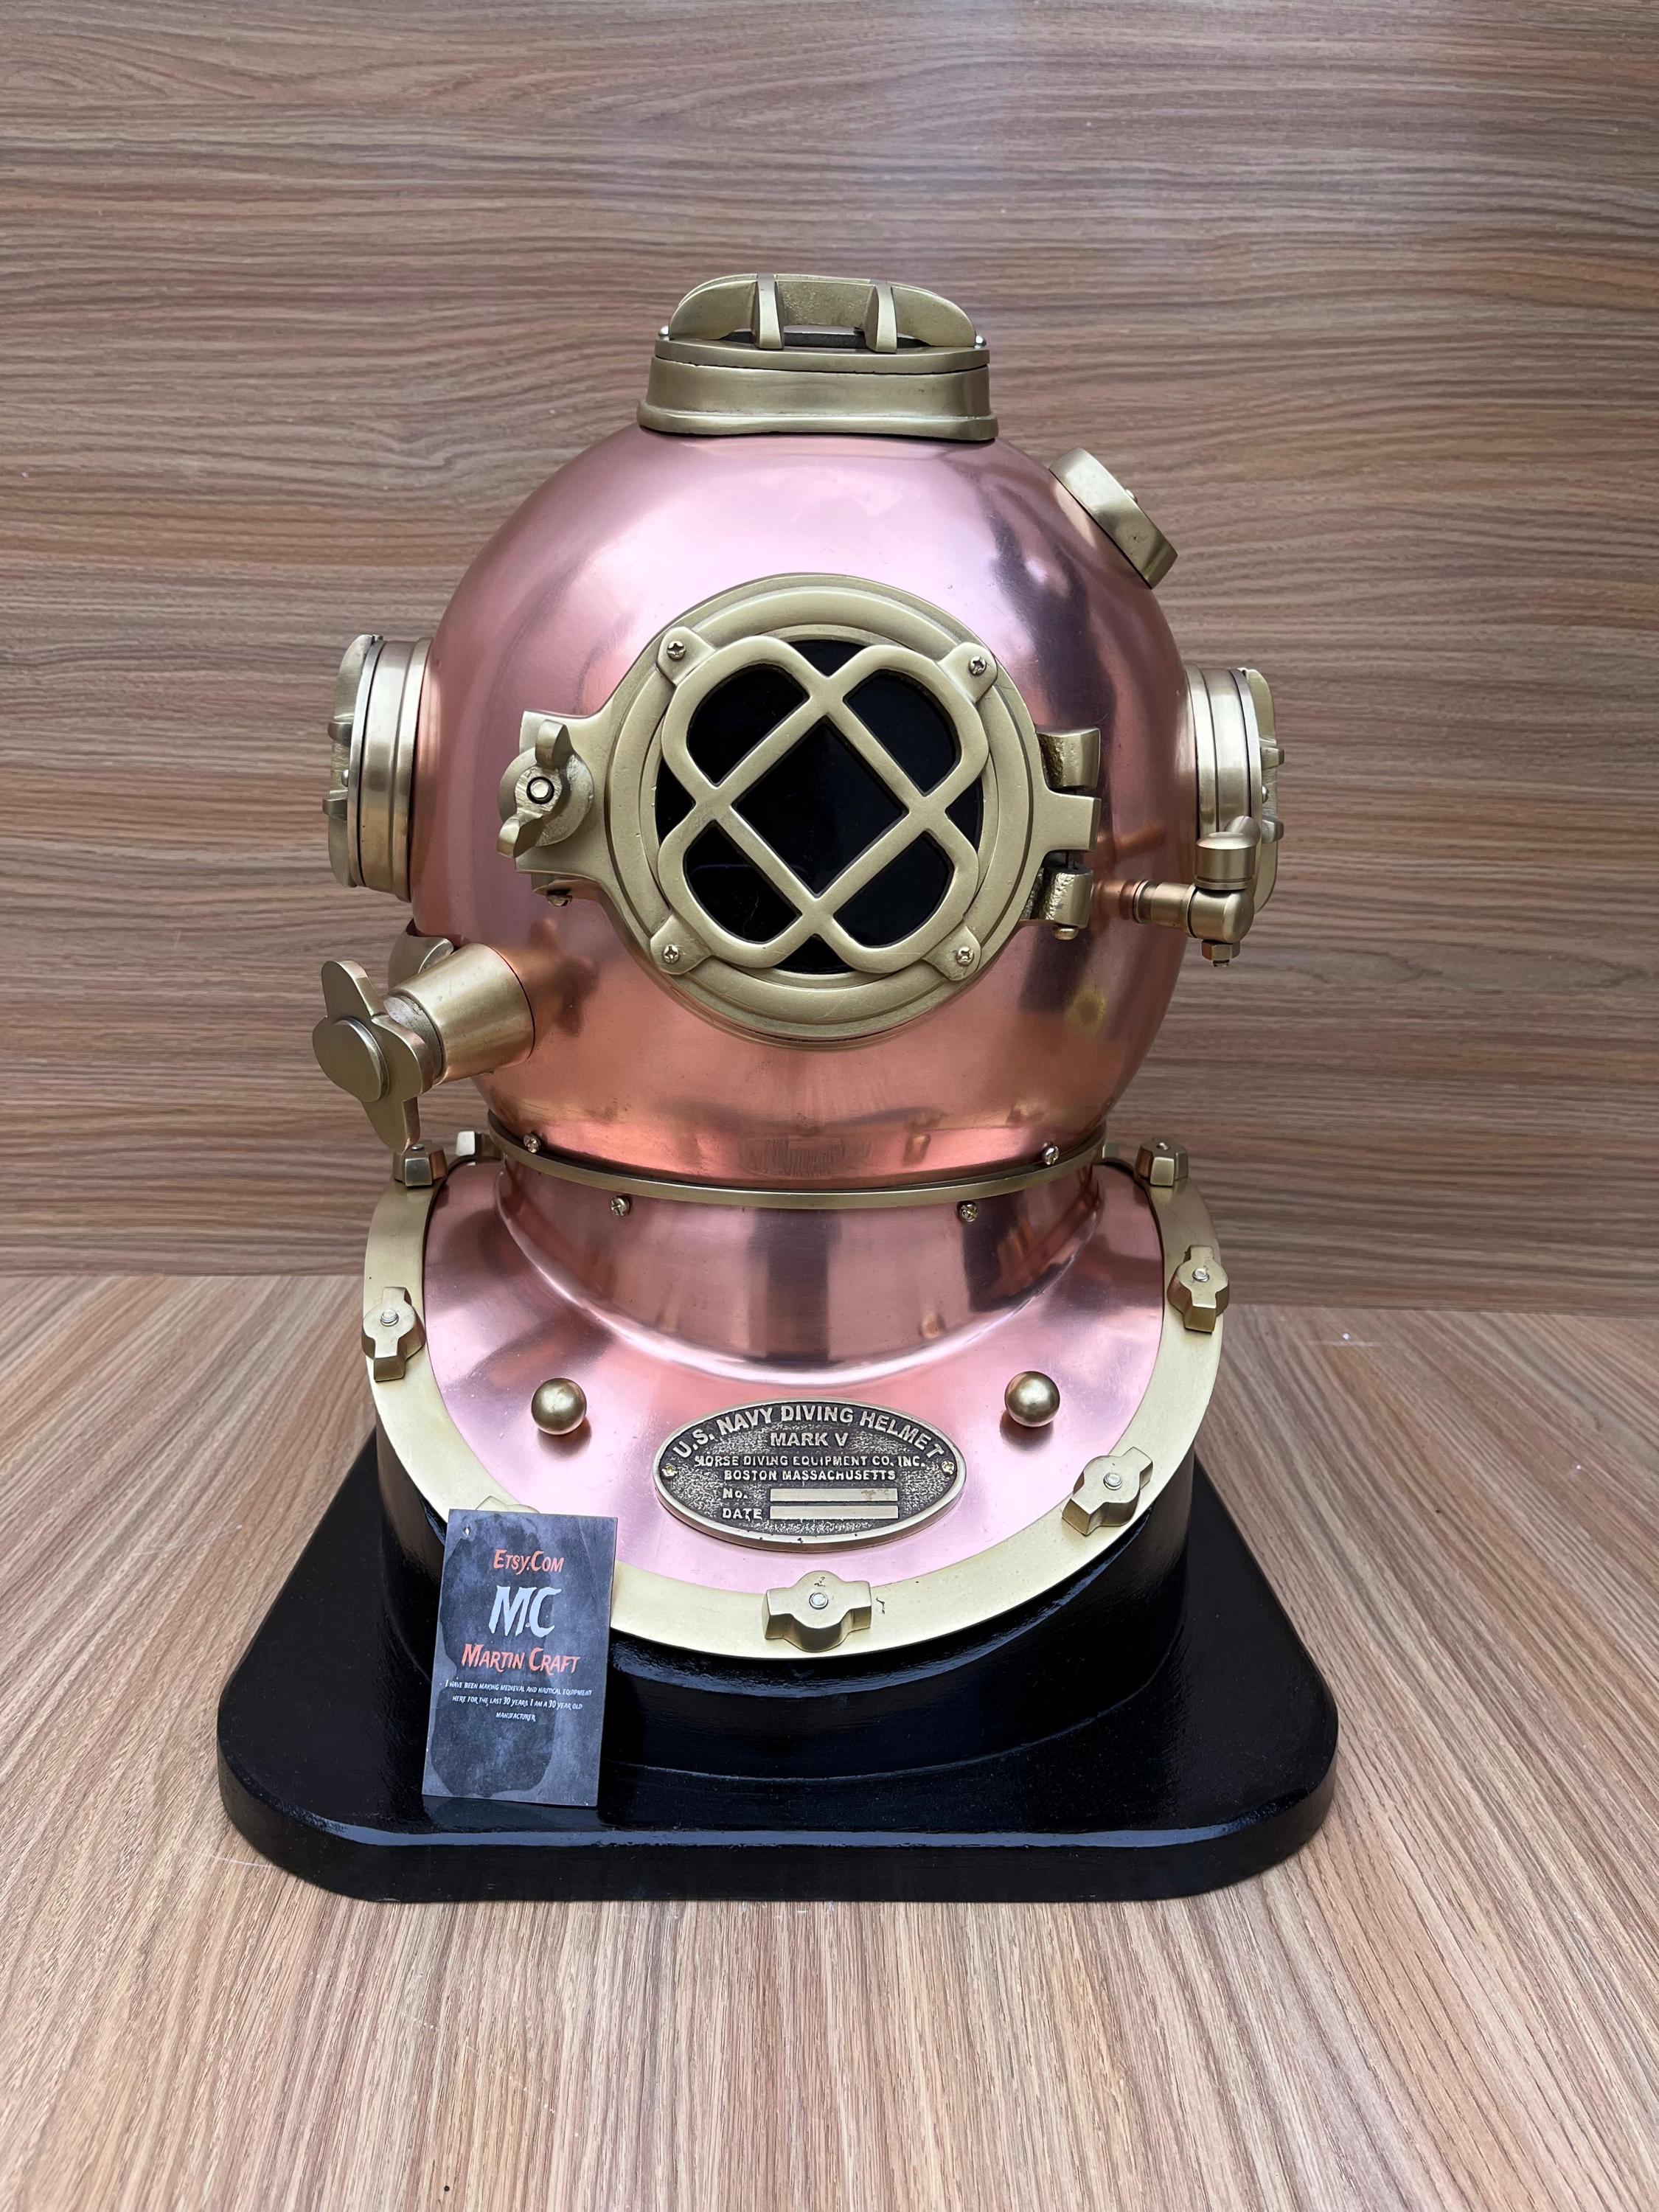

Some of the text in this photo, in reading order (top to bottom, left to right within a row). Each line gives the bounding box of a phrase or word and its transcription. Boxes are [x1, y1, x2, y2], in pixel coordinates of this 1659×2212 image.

[672, 1405, 945, 1458] U.S. NAVY DIVING HELMET
[771, 1433, 849, 1447] MARK V
[743, 1455, 787, 1467] DIVING
[793, 1455, 868, 1467] EQUIPMENT
[872, 1456, 894, 1467] CO.
[898, 1456, 925, 1467] INC.
[724, 1470, 896, 1481] BOSTON MASSACHUSETTS
[722, 1508, 763, 1522] DATE
[488, 1585, 562, 1638] MC
[479, 1683, 499, 1691] MAKING
[500, 1684, 525, 1692] MEDIEVAL
[538, 1687, 561, 1695] NAUTICAL
[563, 1688, 592, 1697] EQUIPMENT
[452, 1695, 466, 1703] HERE
[467, 1696, 479, 1704] FOR
[503, 1697, 511, 1705] 30
[510, 1699, 528, 1707] YEARS
[548, 1700, 557, 1708] 30
[556, 1703, 572, 1711] YEAR
[495, 1712, 536, 1722] MANUFACTURER
